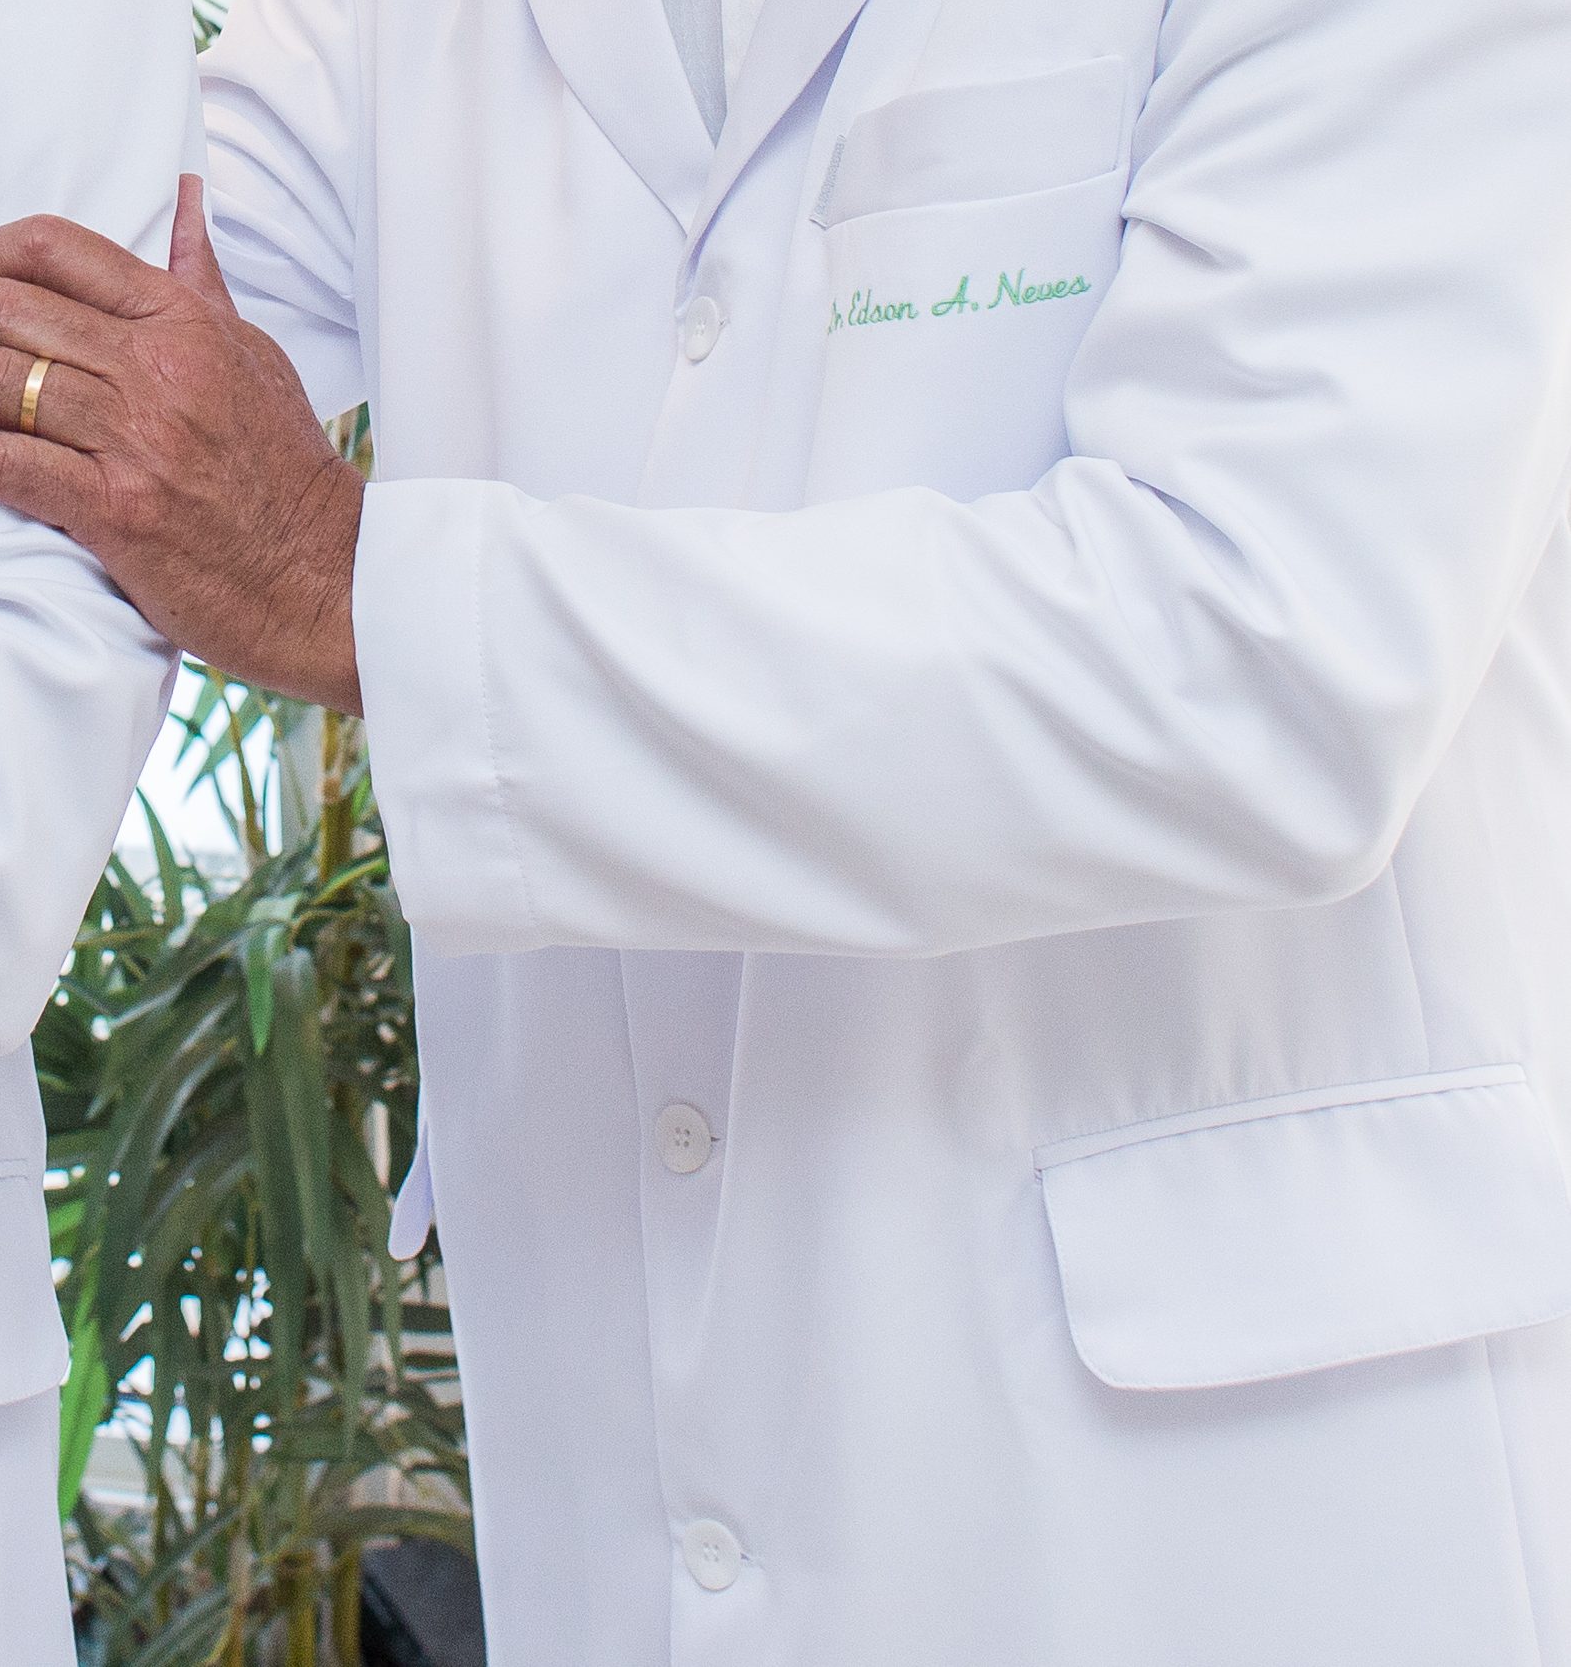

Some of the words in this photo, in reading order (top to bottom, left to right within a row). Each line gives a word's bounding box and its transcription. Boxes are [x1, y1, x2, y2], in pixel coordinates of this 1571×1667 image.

[847, 288, 920, 327] Edson
[930, 275, 981, 318] A.
[987, 268, 1092, 312] Neves
